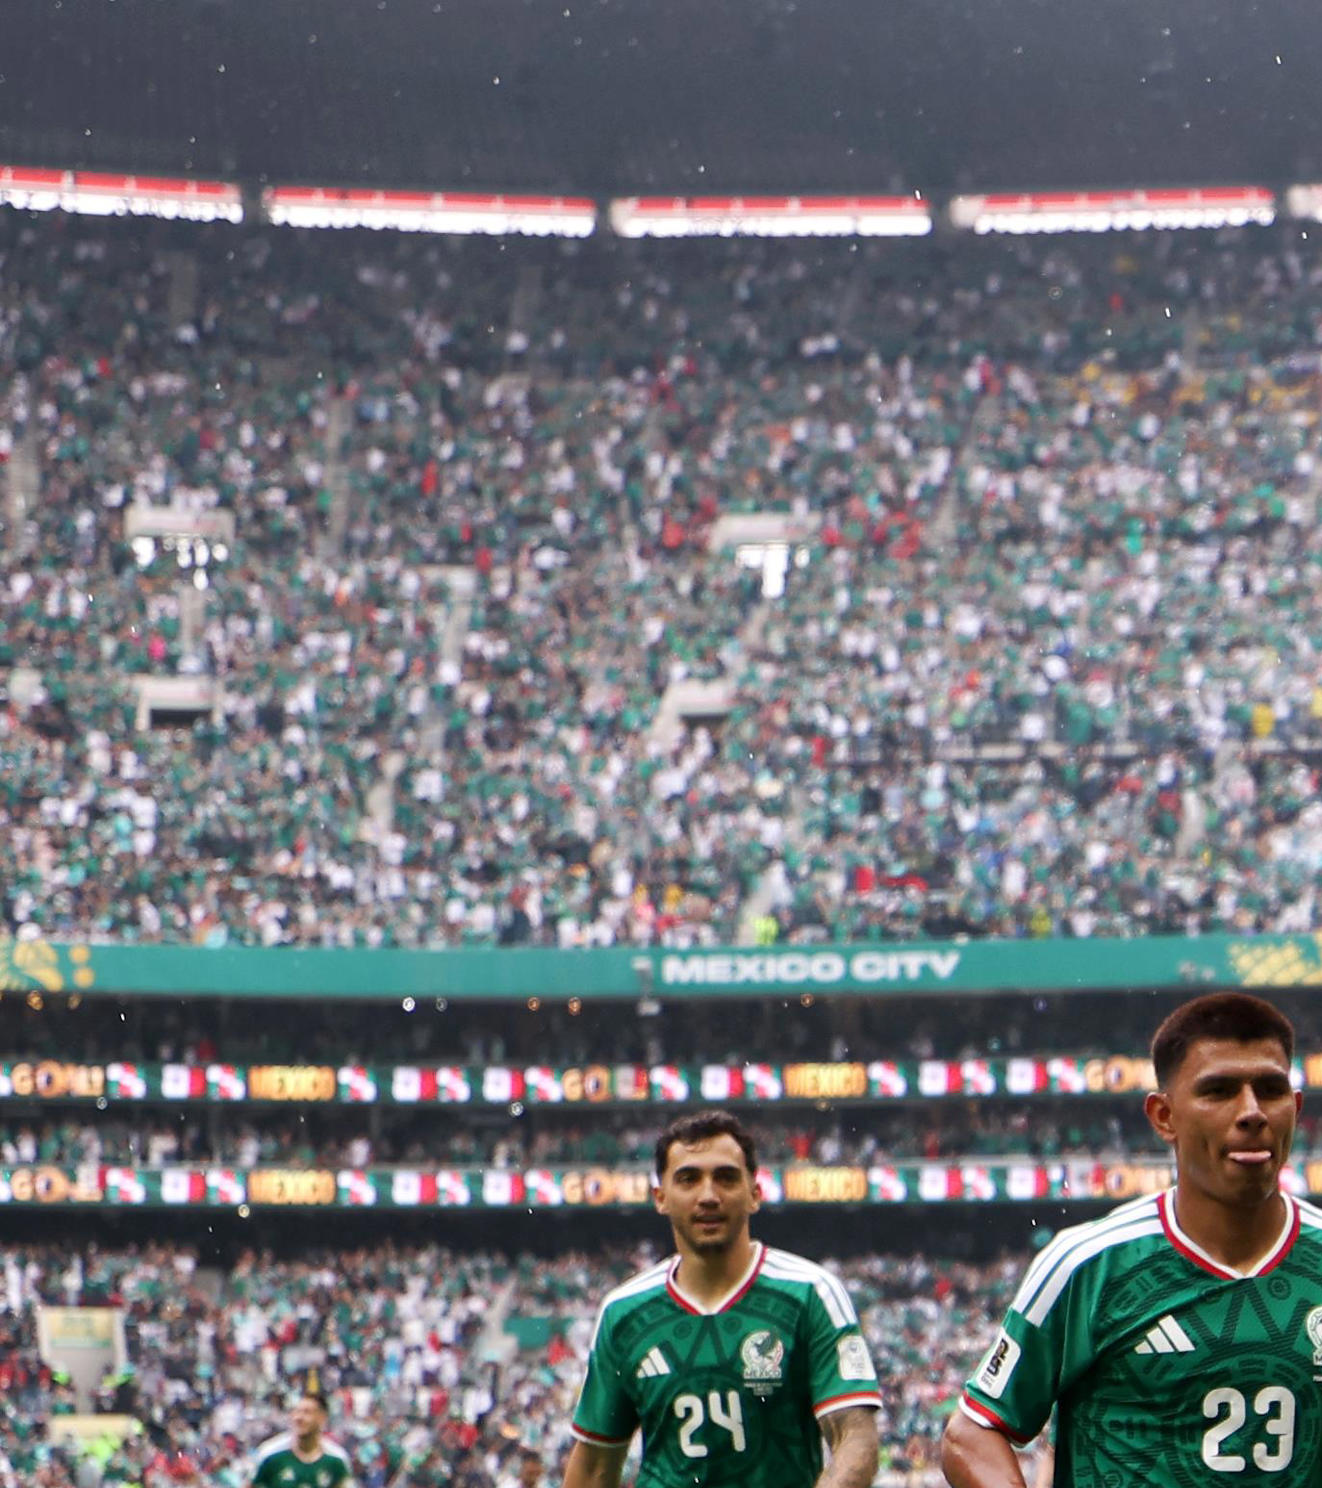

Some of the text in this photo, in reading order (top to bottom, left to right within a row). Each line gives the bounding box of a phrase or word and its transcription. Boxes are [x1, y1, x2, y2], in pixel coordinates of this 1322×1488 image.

[662, 950, 961, 984] MEXICO CITY
[673, 1390, 747, 1459] 24
[1201, 1385, 1297, 1473] 23
